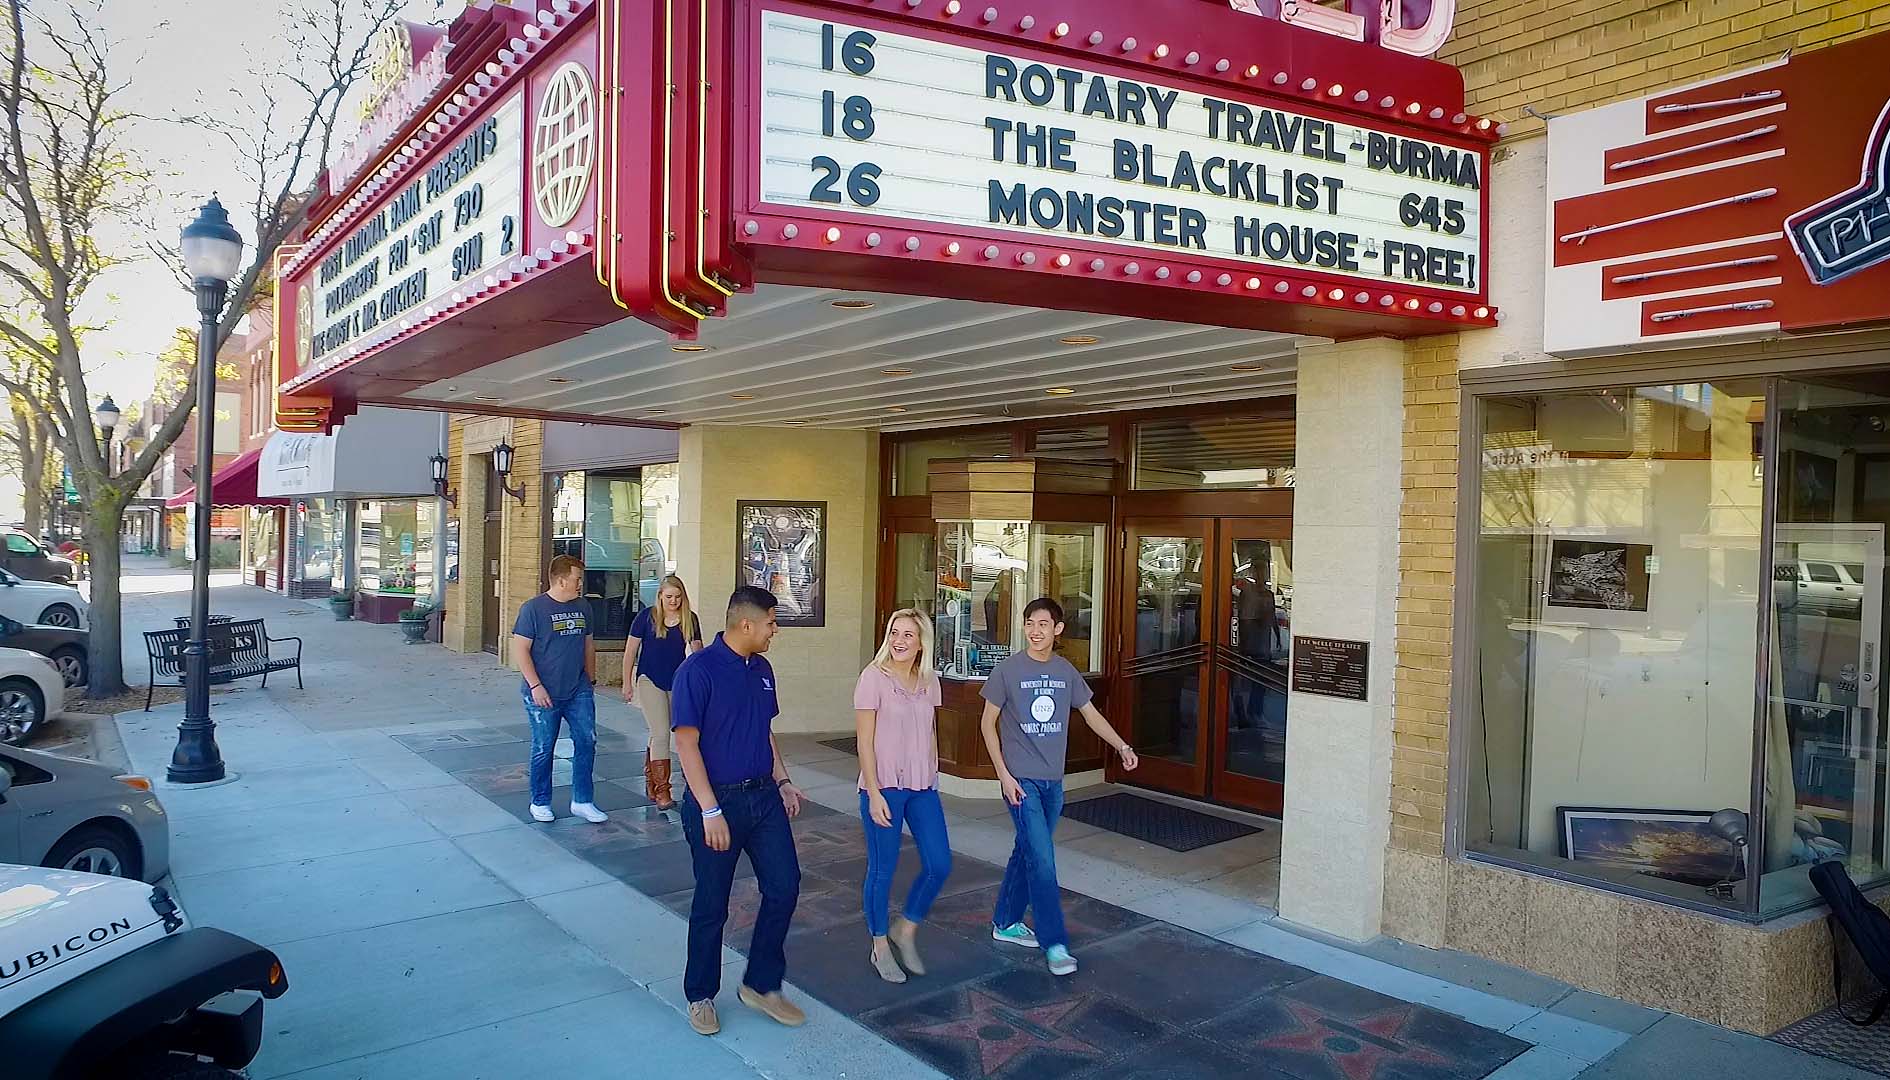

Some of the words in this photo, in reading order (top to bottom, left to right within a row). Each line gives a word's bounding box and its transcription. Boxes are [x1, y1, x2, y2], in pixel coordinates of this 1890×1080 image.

[821, 24, 877, 76] 16
[984, 54, 1178, 129] ROTARY
[345, 210, 388, 268] NATIONAL
[391, 179, 421, 232] BANK
[426, 116, 497, 203] PRESENTS
[453, 182, 483, 232] 730
[809, 155, 882, 207] 26
[988, 180, 1207, 250] MONSTER
[821, 90, 876, 141] 18
[985, 117, 1077, 172] THE
[1113, 138, 1343, 215] BLACKLIST
[1400, 192, 1466, 235] 645
[380, 267, 427, 321] CHICKEN
[452, 231, 483, 281] SUN
[500, 214, 514, 256] 2
